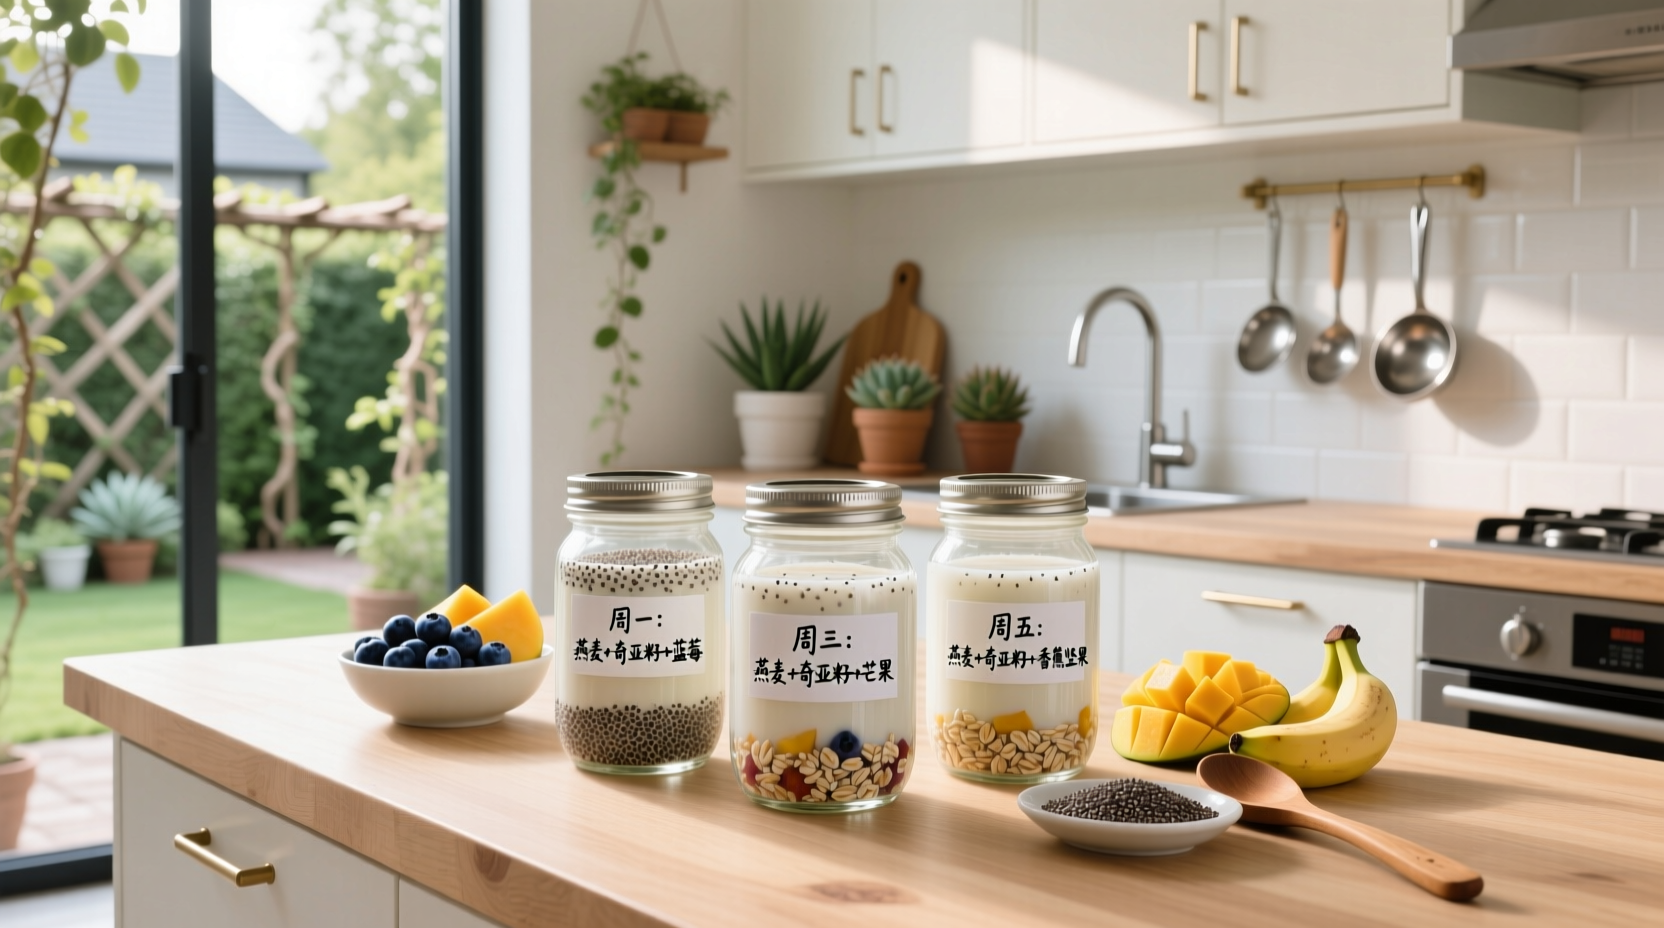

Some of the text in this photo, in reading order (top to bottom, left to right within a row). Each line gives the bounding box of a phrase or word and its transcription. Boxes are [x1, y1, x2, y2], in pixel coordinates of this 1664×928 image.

[609, 606, 663, 635] 周一:
[988, 612, 1043, 642] 周五:
[792, 624, 852, 656] 周三:
[753, 656, 895, 689] 燕麦+奇亚籽+芒果
